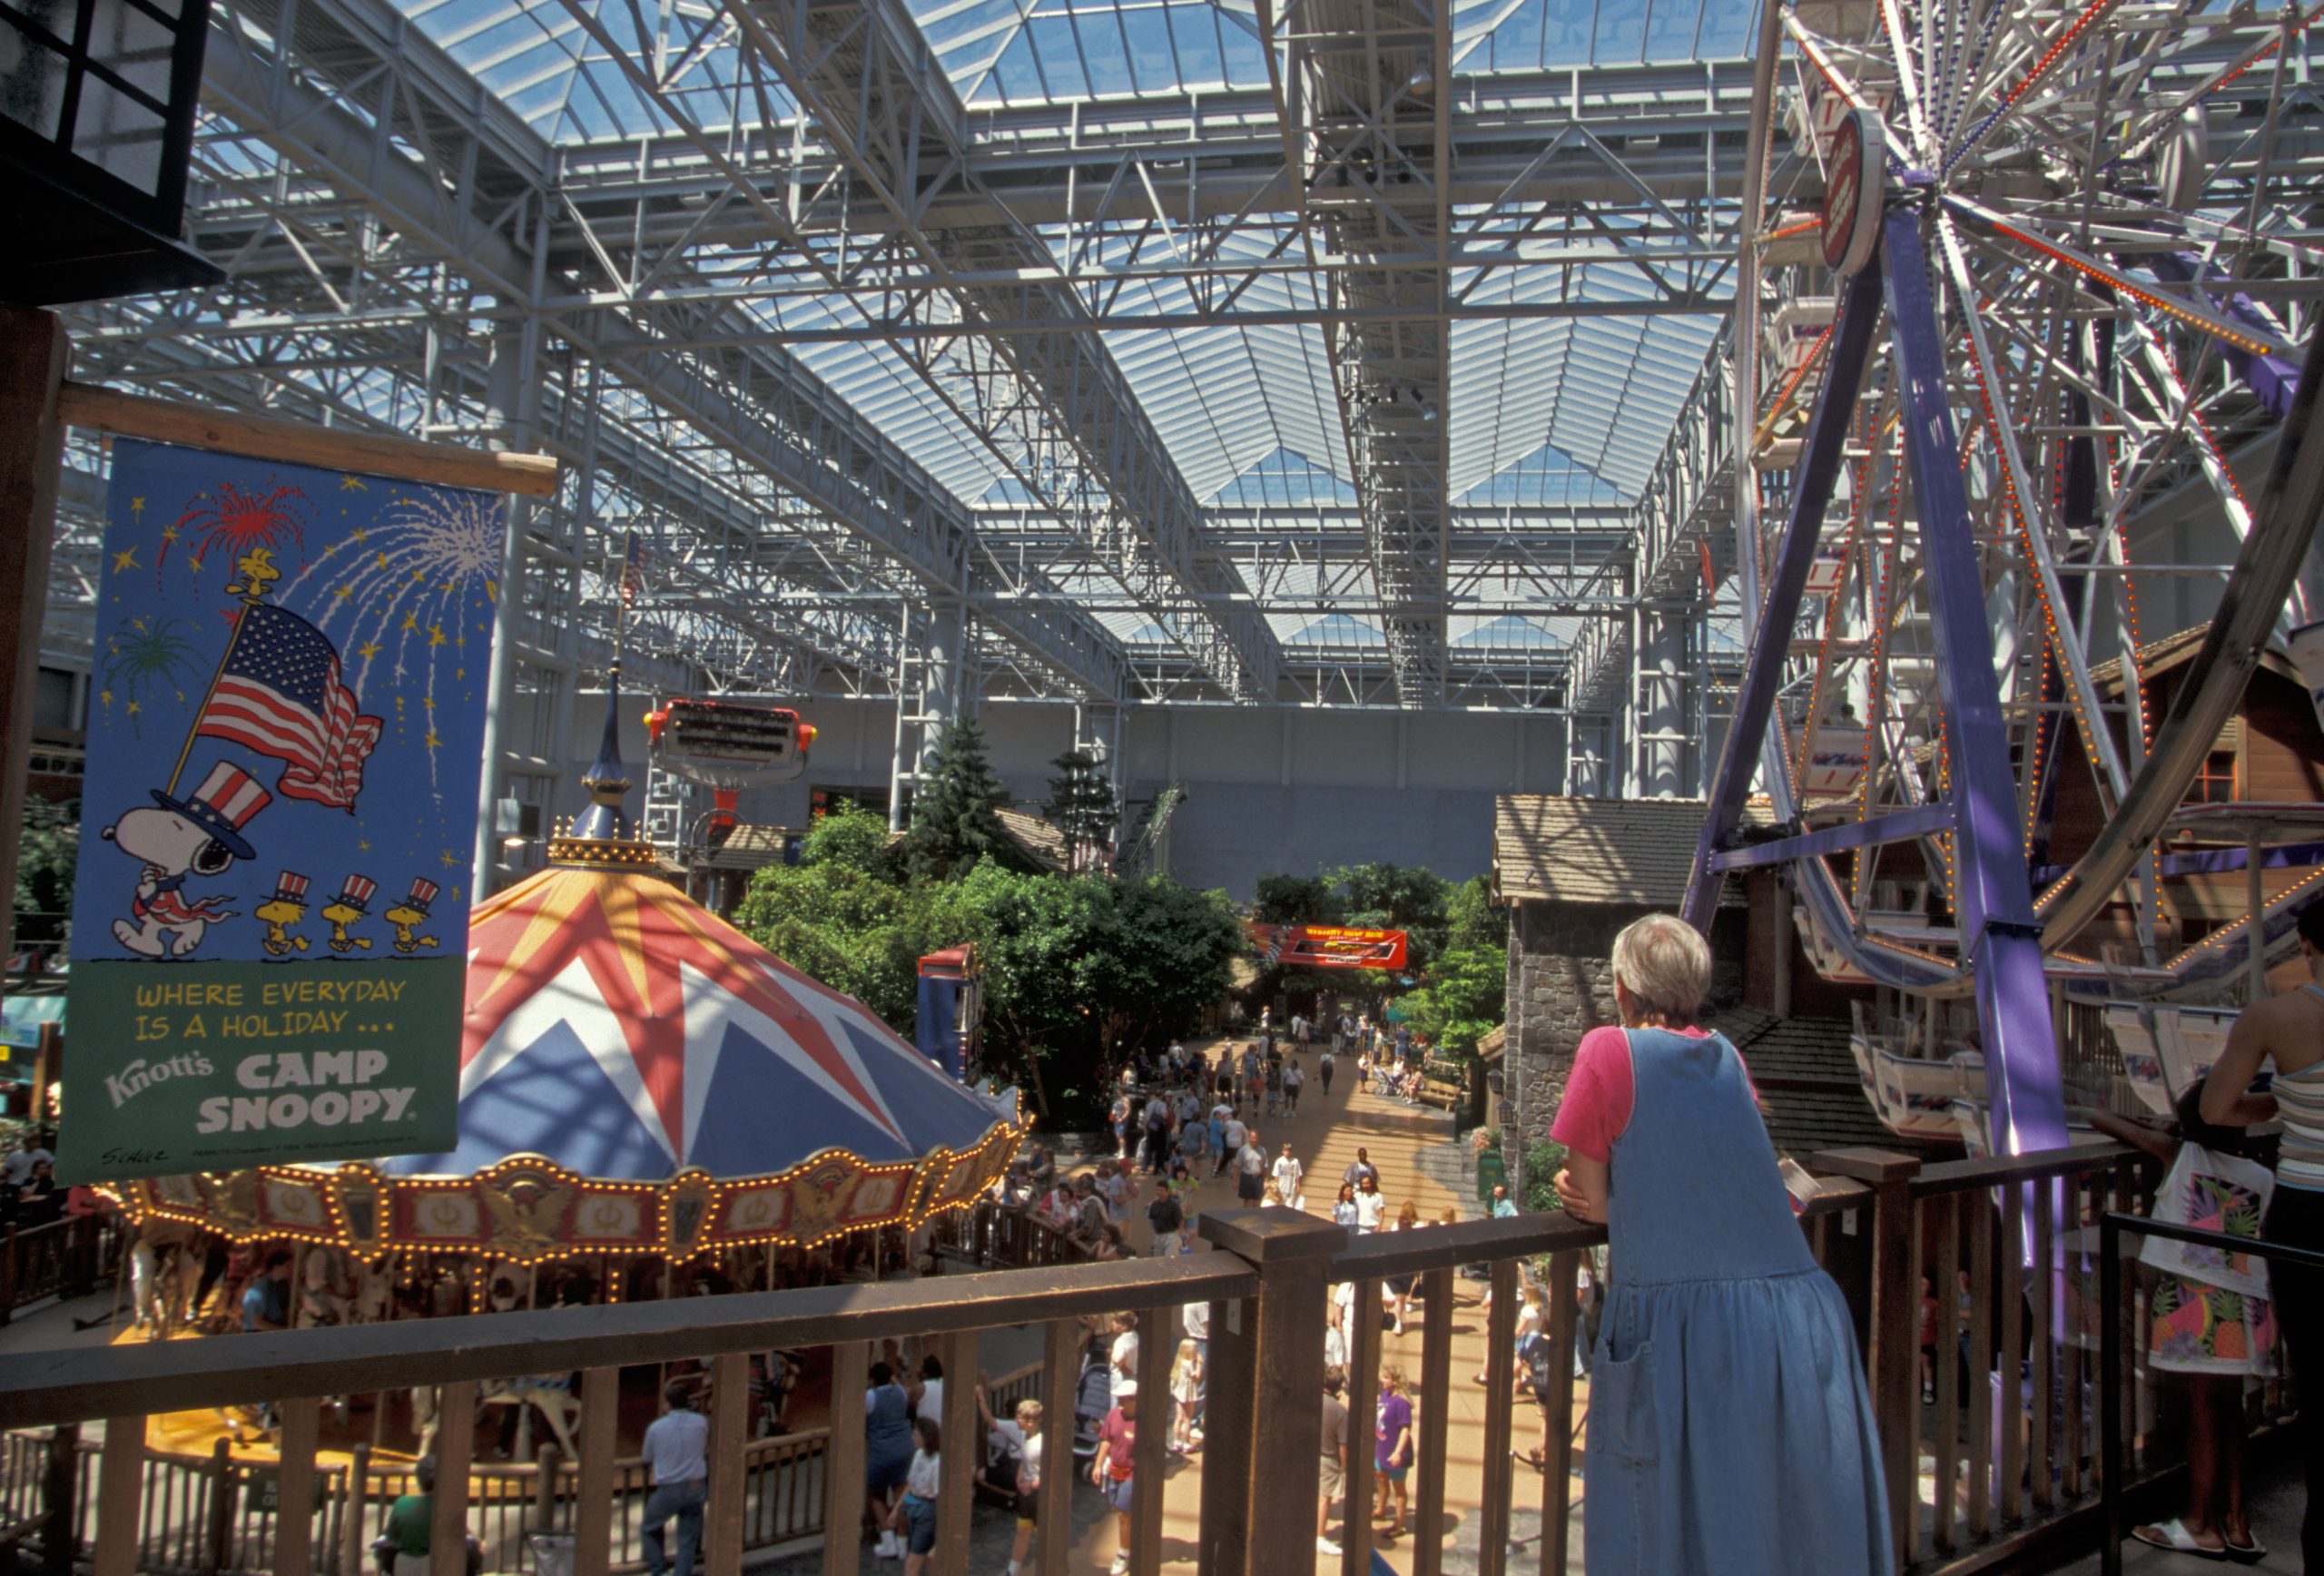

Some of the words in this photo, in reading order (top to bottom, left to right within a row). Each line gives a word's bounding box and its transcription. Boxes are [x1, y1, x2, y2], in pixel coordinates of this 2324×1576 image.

[135, 983, 244, 1009] WHERE
[261, 980, 407, 1003] EVERYDAY
[134, 1014, 171, 1041] IS
[183, 1014, 208, 1038] A
[222, 1010, 349, 1038] HOLIDAY
[103, 1049, 214, 1109] Knott's
[235, 1049, 389, 1089] CAMP
[195, 1088, 418, 1135] SNOOPY
